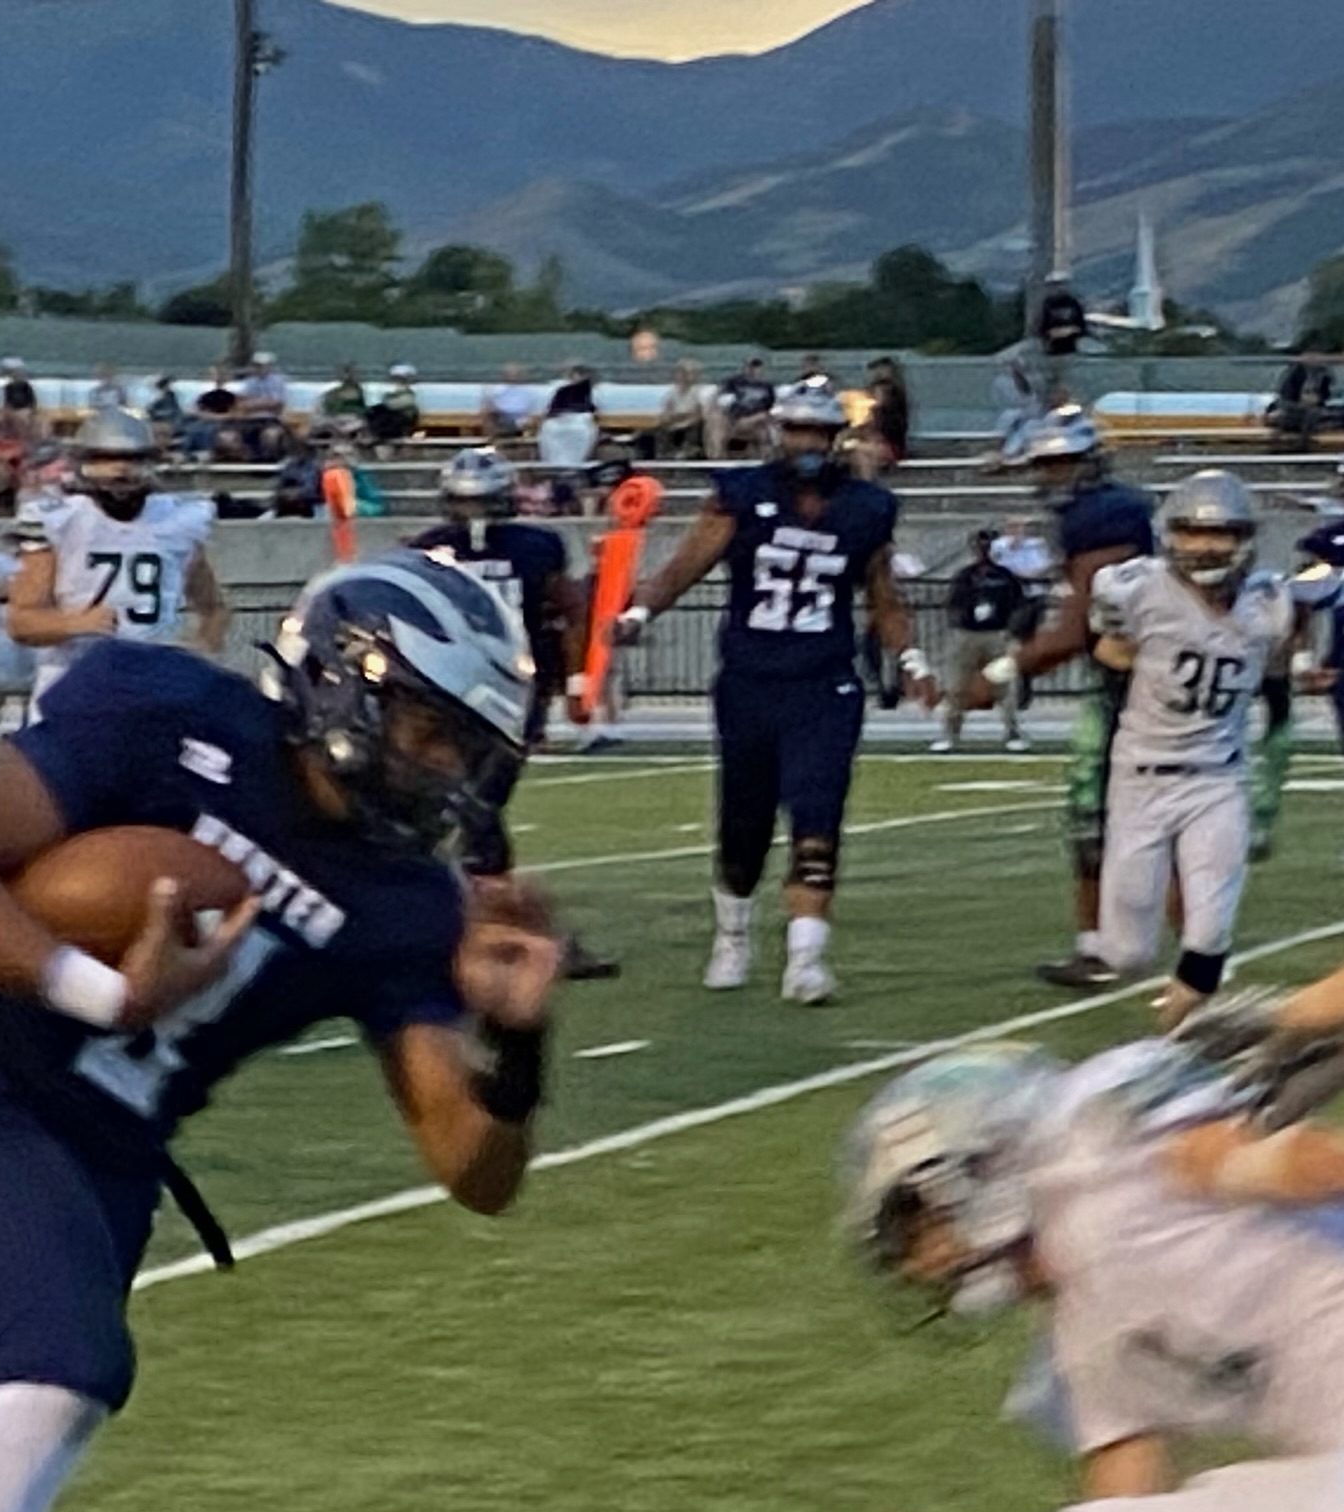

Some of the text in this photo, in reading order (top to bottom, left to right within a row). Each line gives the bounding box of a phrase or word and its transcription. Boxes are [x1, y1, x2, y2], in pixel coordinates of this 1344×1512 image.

[83, 552, 162, 625] 79
[748, 543, 847, 633] 55
[1167, 650, 1246, 719] 36
